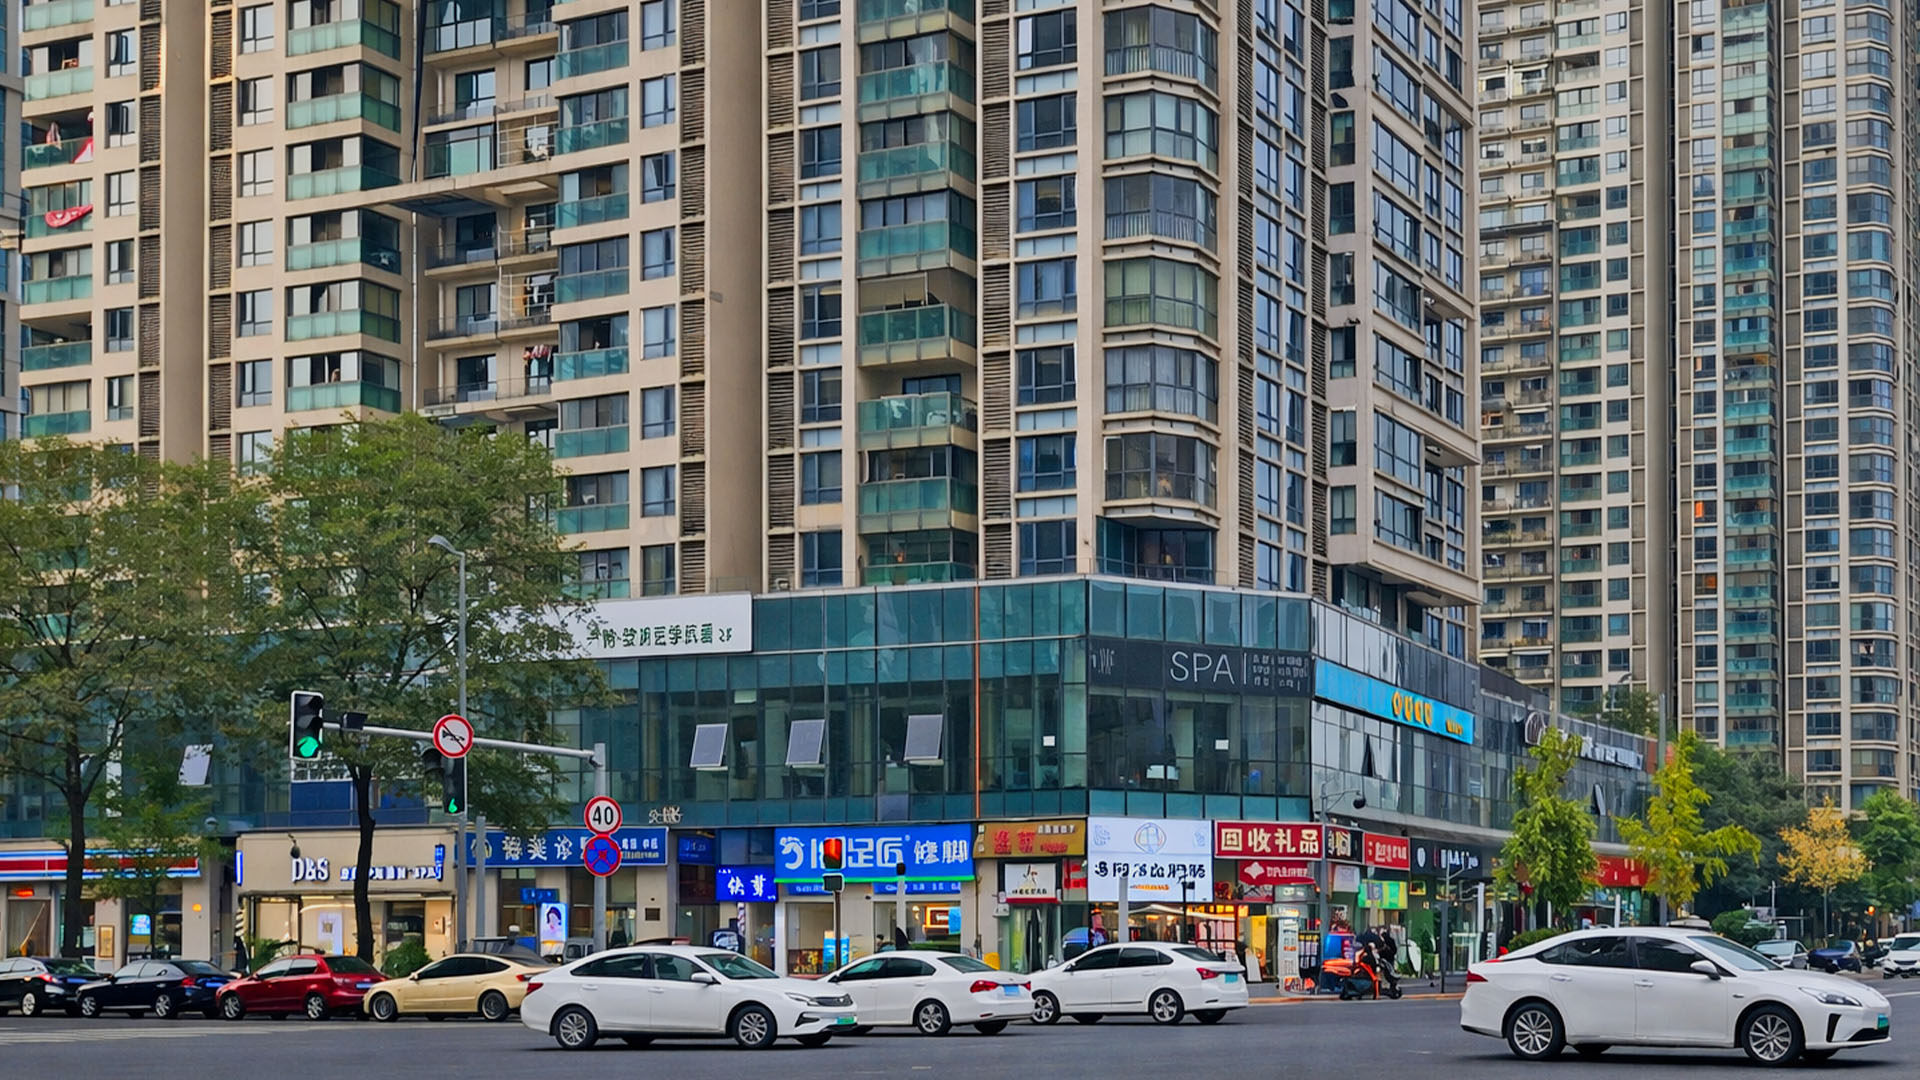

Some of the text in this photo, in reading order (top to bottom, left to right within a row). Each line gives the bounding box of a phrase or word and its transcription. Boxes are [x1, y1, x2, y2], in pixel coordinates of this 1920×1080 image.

[1170, 650, 1235, 685] SPA
[592, 805, 614, 826] 40
[1221, 827, 1319, 854] 回收礼品
